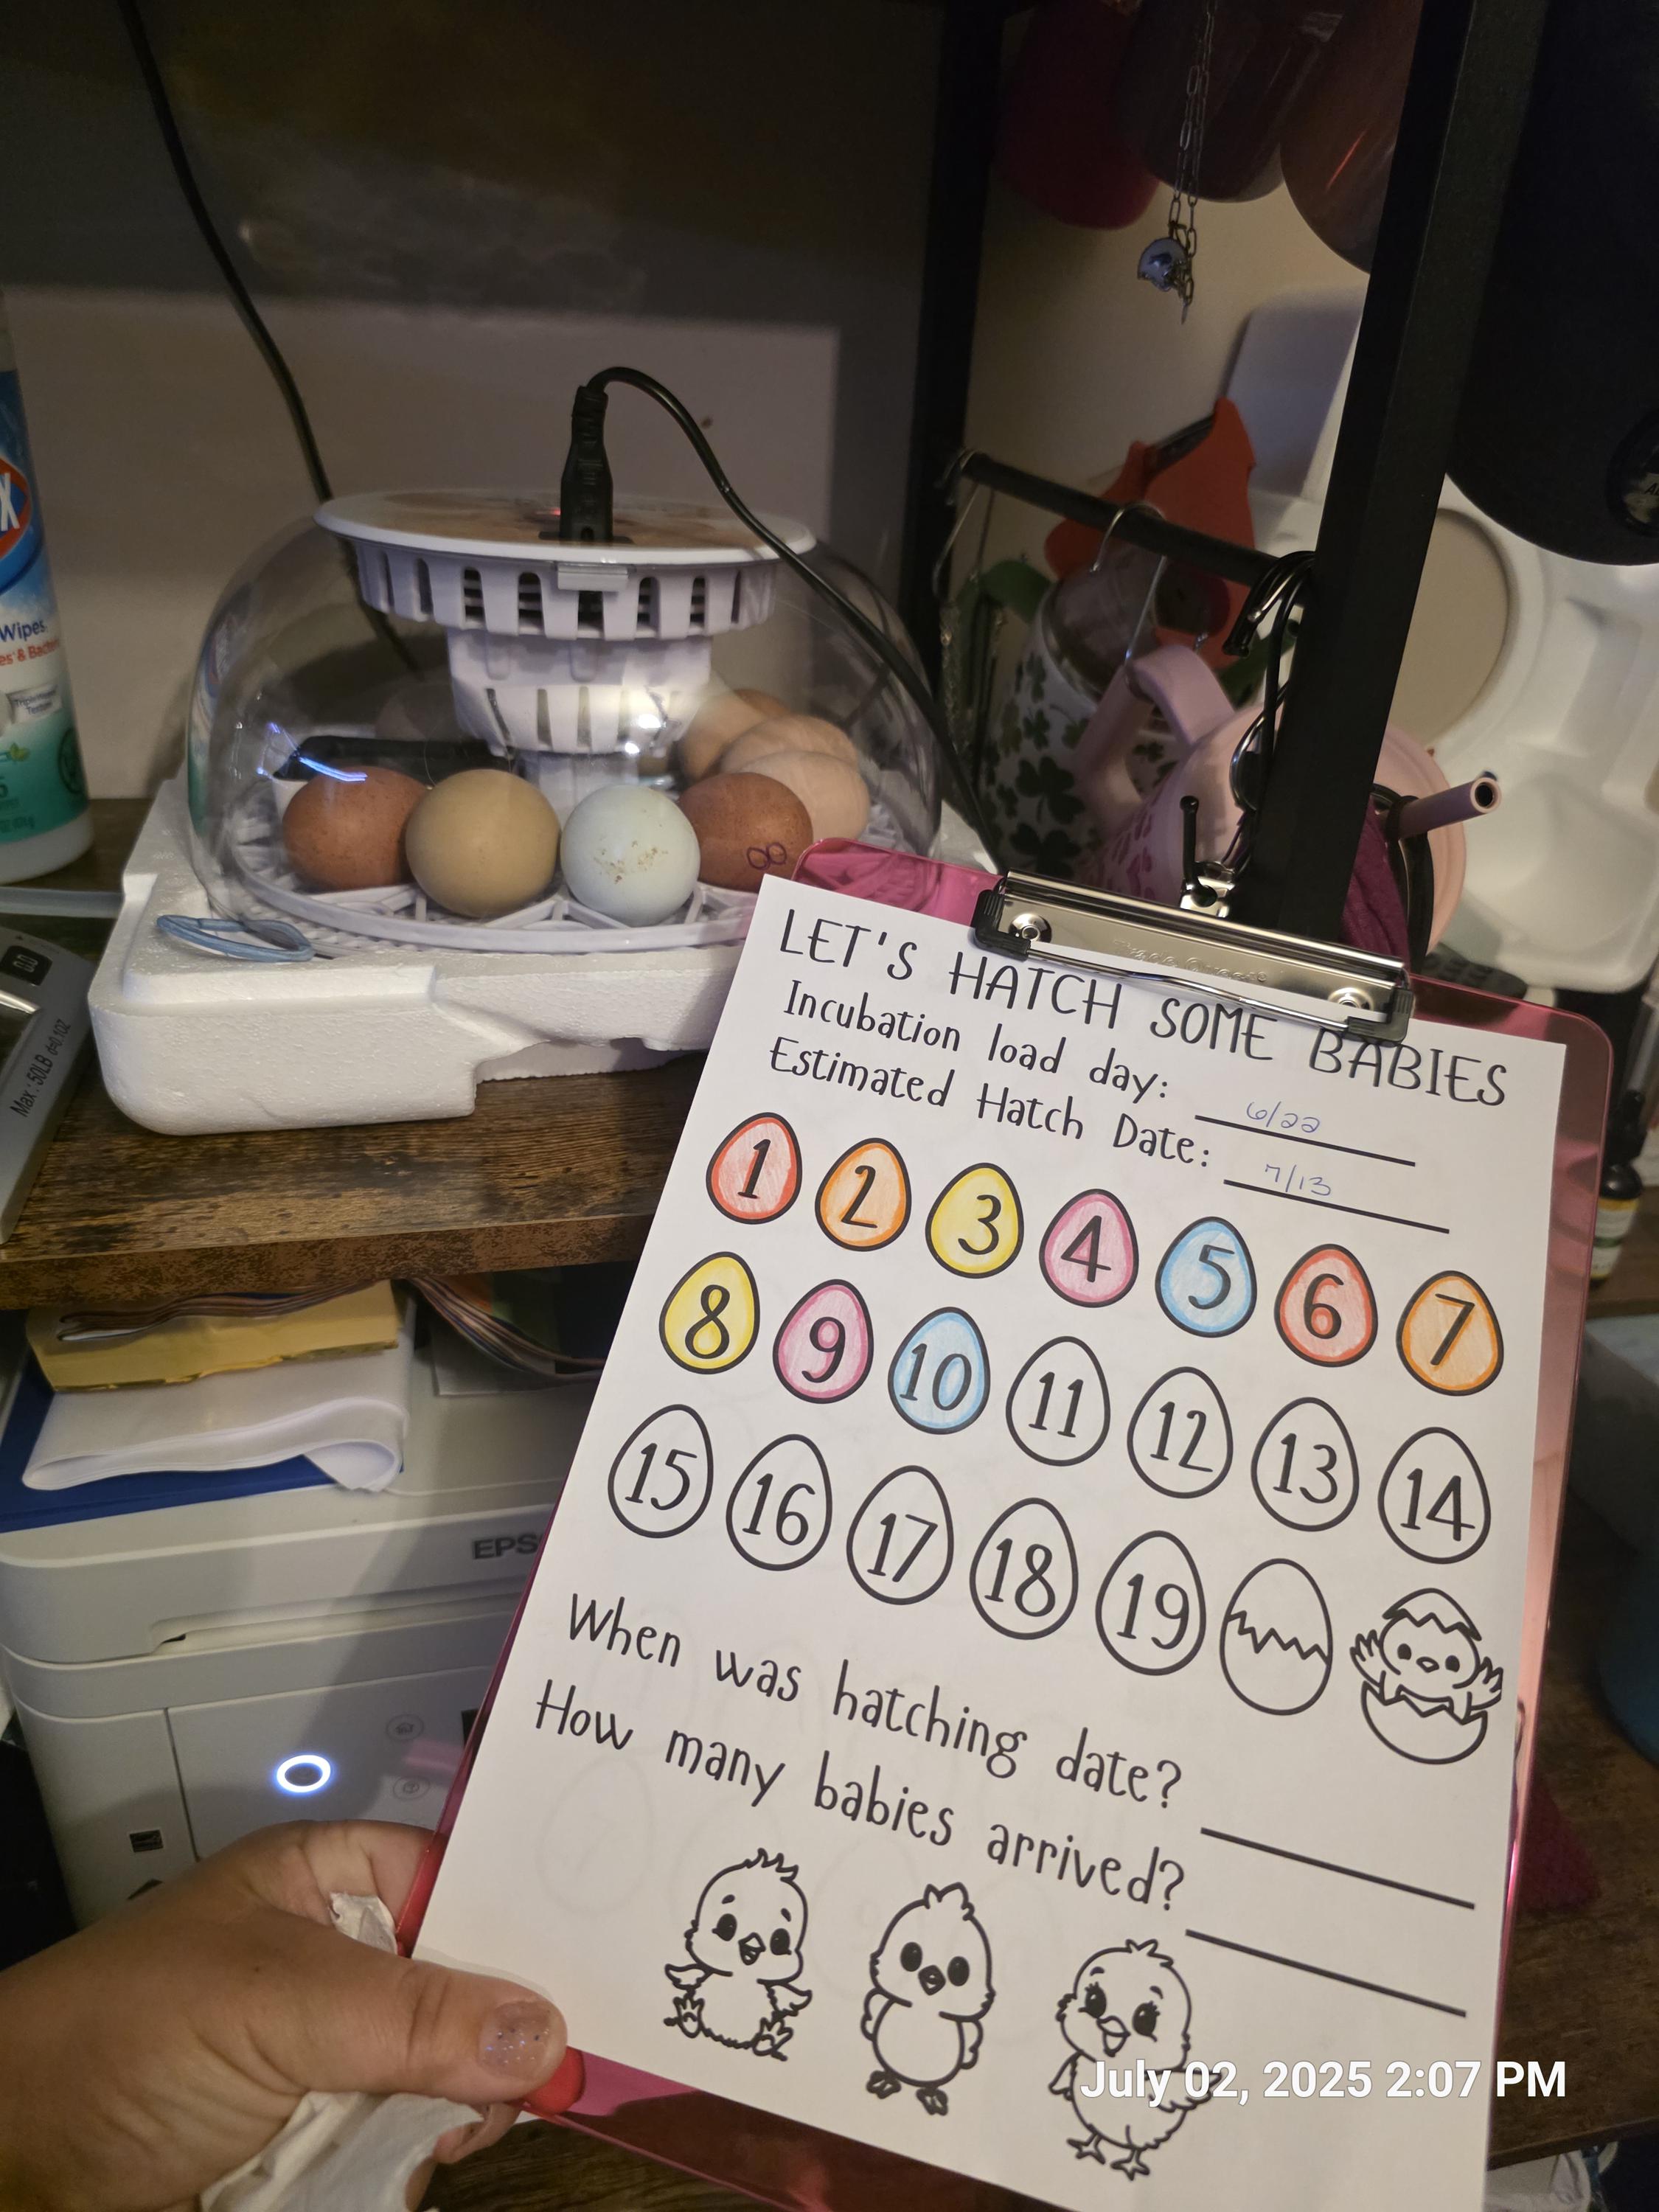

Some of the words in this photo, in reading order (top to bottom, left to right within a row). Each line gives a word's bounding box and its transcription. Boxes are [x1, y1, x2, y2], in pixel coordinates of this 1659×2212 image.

[0, 620, 45, 642] Wipes
[779, 908, 918, 981] LET'S
[948, 950, 1123, 1030] HATCH
[1149, 996, 1279, 1061] SOME
[1308, 1026, 1508, 1107] BABIES
[782, 979, 961, 1052] Incubation
[987, 1022, 1067, 1075] load
[1088, 1047, 1168, 1105] day:
[769, 1035, 956, 1107] Estimated
[975, 1082, 1084, 1141] Hatch
[1112, 1112, 1211, 1168] Date:
[1246, 1101, 1321, 1134] 6/22
[1263, 1163, 1333, 1197] 7/13
[737, 1138, 772, 1200] 1
[840, 1164, 879, 1230] 2
[957, 1194, 1003, 1256] 3
[1060, 1214, 1113, 1284] 4
[1188, 1243, 1237, 1311] 5
[1302, 1272, 1345, 1341] 6
[1430, 1293, 1475, 1366] 7
[684, 1284, 731, 1360] 8
[801, 1316, 846, 1384] 9
[900, 1343, 973, 1413] 10
[1029, 1371, 1085, 1439] 11
[1150, 1400, 1214, 1473] 12
[1272, 1432, 1339, 1505] 13
[1399, 1467, 1477, 1543] 14
[474, 1532, 543, 1559] EPS
[625, 1442, 698, 1512] 15
[741, 1472, 816, 1547] 16
[866, 1512, 940, 1584] 17
[984, 1537, 1057, 1618] 18
[1116, 1573, 1190, 1652] 19
[568, 1592, 681, 1669] When
[715, 1649, 803, 1703] was
[832, 1658, 1029, 1781] hatching
[1055, 1726, 1183, 1809] date?
[535, 1678, 635, 1751] How
[664, 1729, 787, 1809] many
[813, 1749, 956, 1848] babies
[987, 1823, 1186, 1911] arrived?
